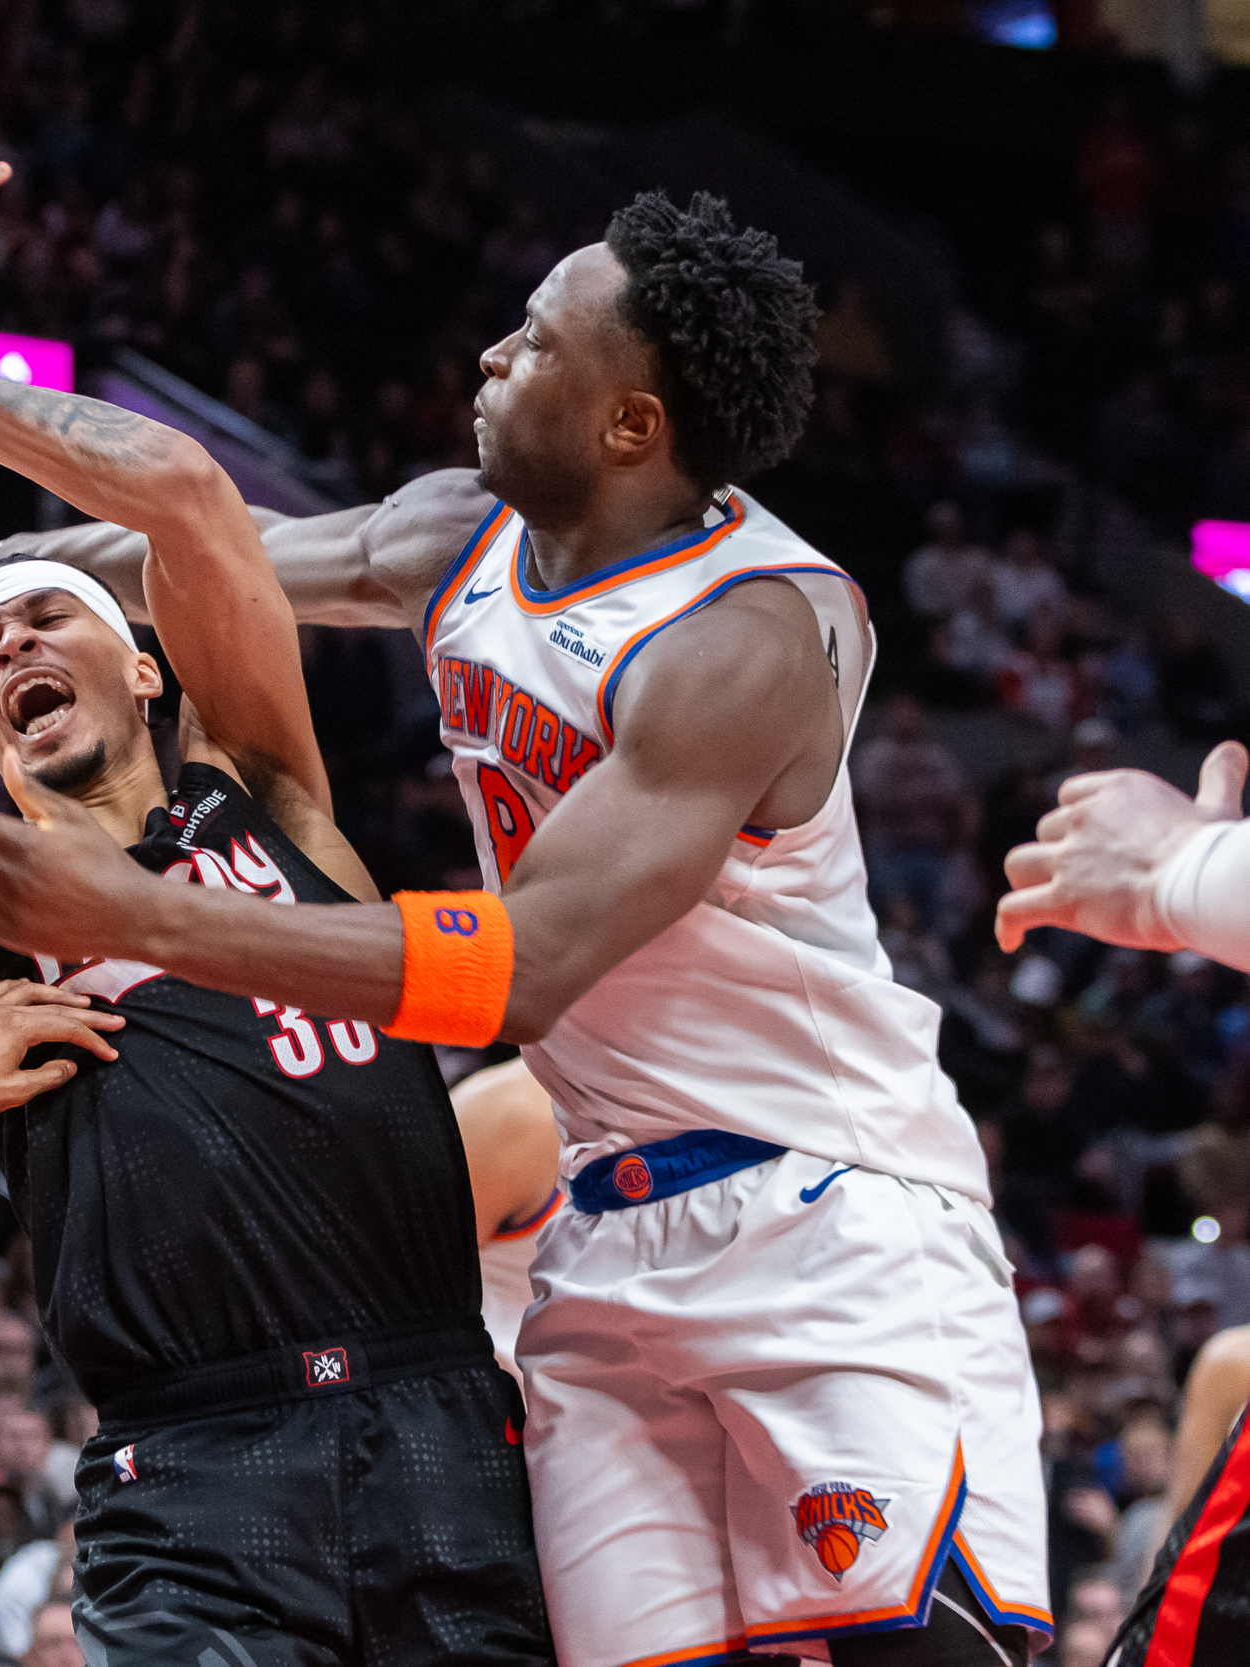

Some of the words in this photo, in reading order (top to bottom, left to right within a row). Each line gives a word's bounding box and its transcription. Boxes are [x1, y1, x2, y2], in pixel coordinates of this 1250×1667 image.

[550, 629, 570, 650] abu
[438, 654, 494, 740] NEW
[494, 667, 601, 796] YORK
[434, 908, 479, 938] 8
[797, 1488, 888, 1536] KNICKS
